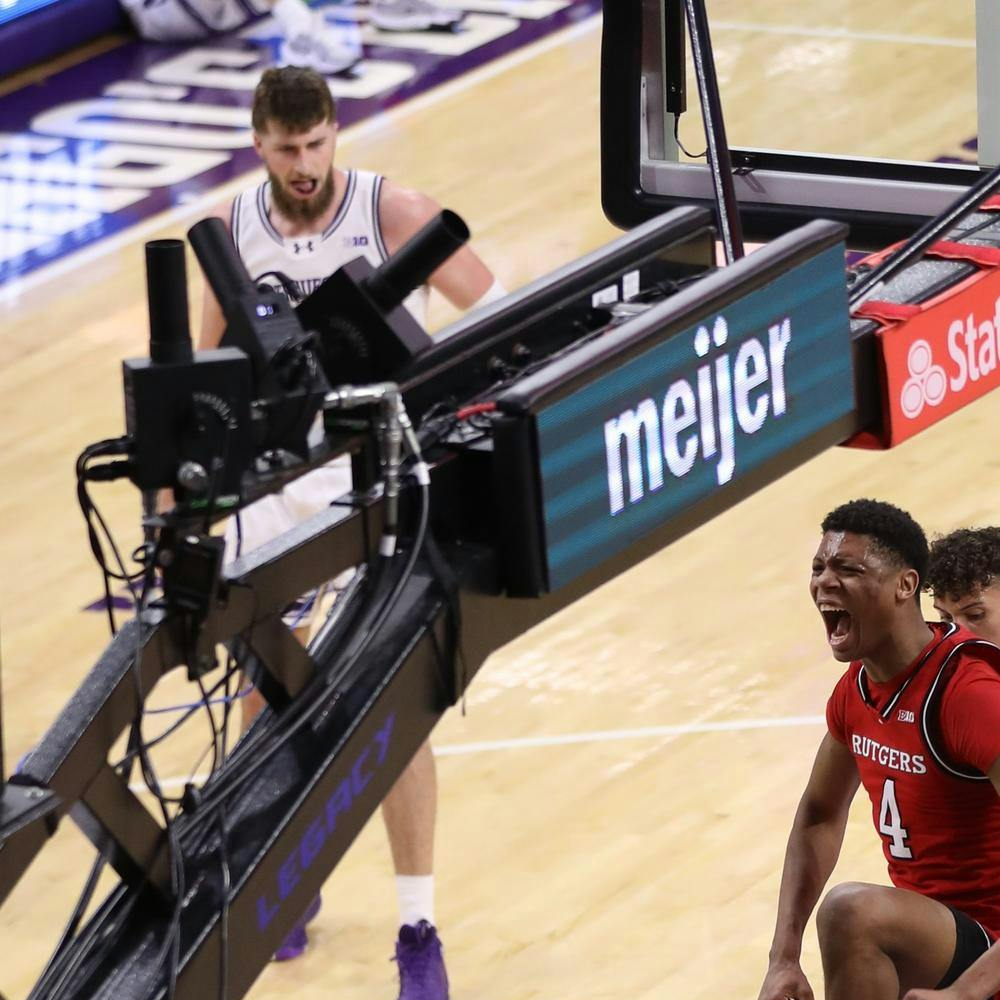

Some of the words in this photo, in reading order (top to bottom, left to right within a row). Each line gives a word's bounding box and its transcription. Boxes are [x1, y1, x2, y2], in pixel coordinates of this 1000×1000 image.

[603, 314, 792, 517] meijer
[256, 710, 397, 934] LEGACY
[851, 733, 928, 775] RUTGERS
[879, 777, 913, 860] 4
